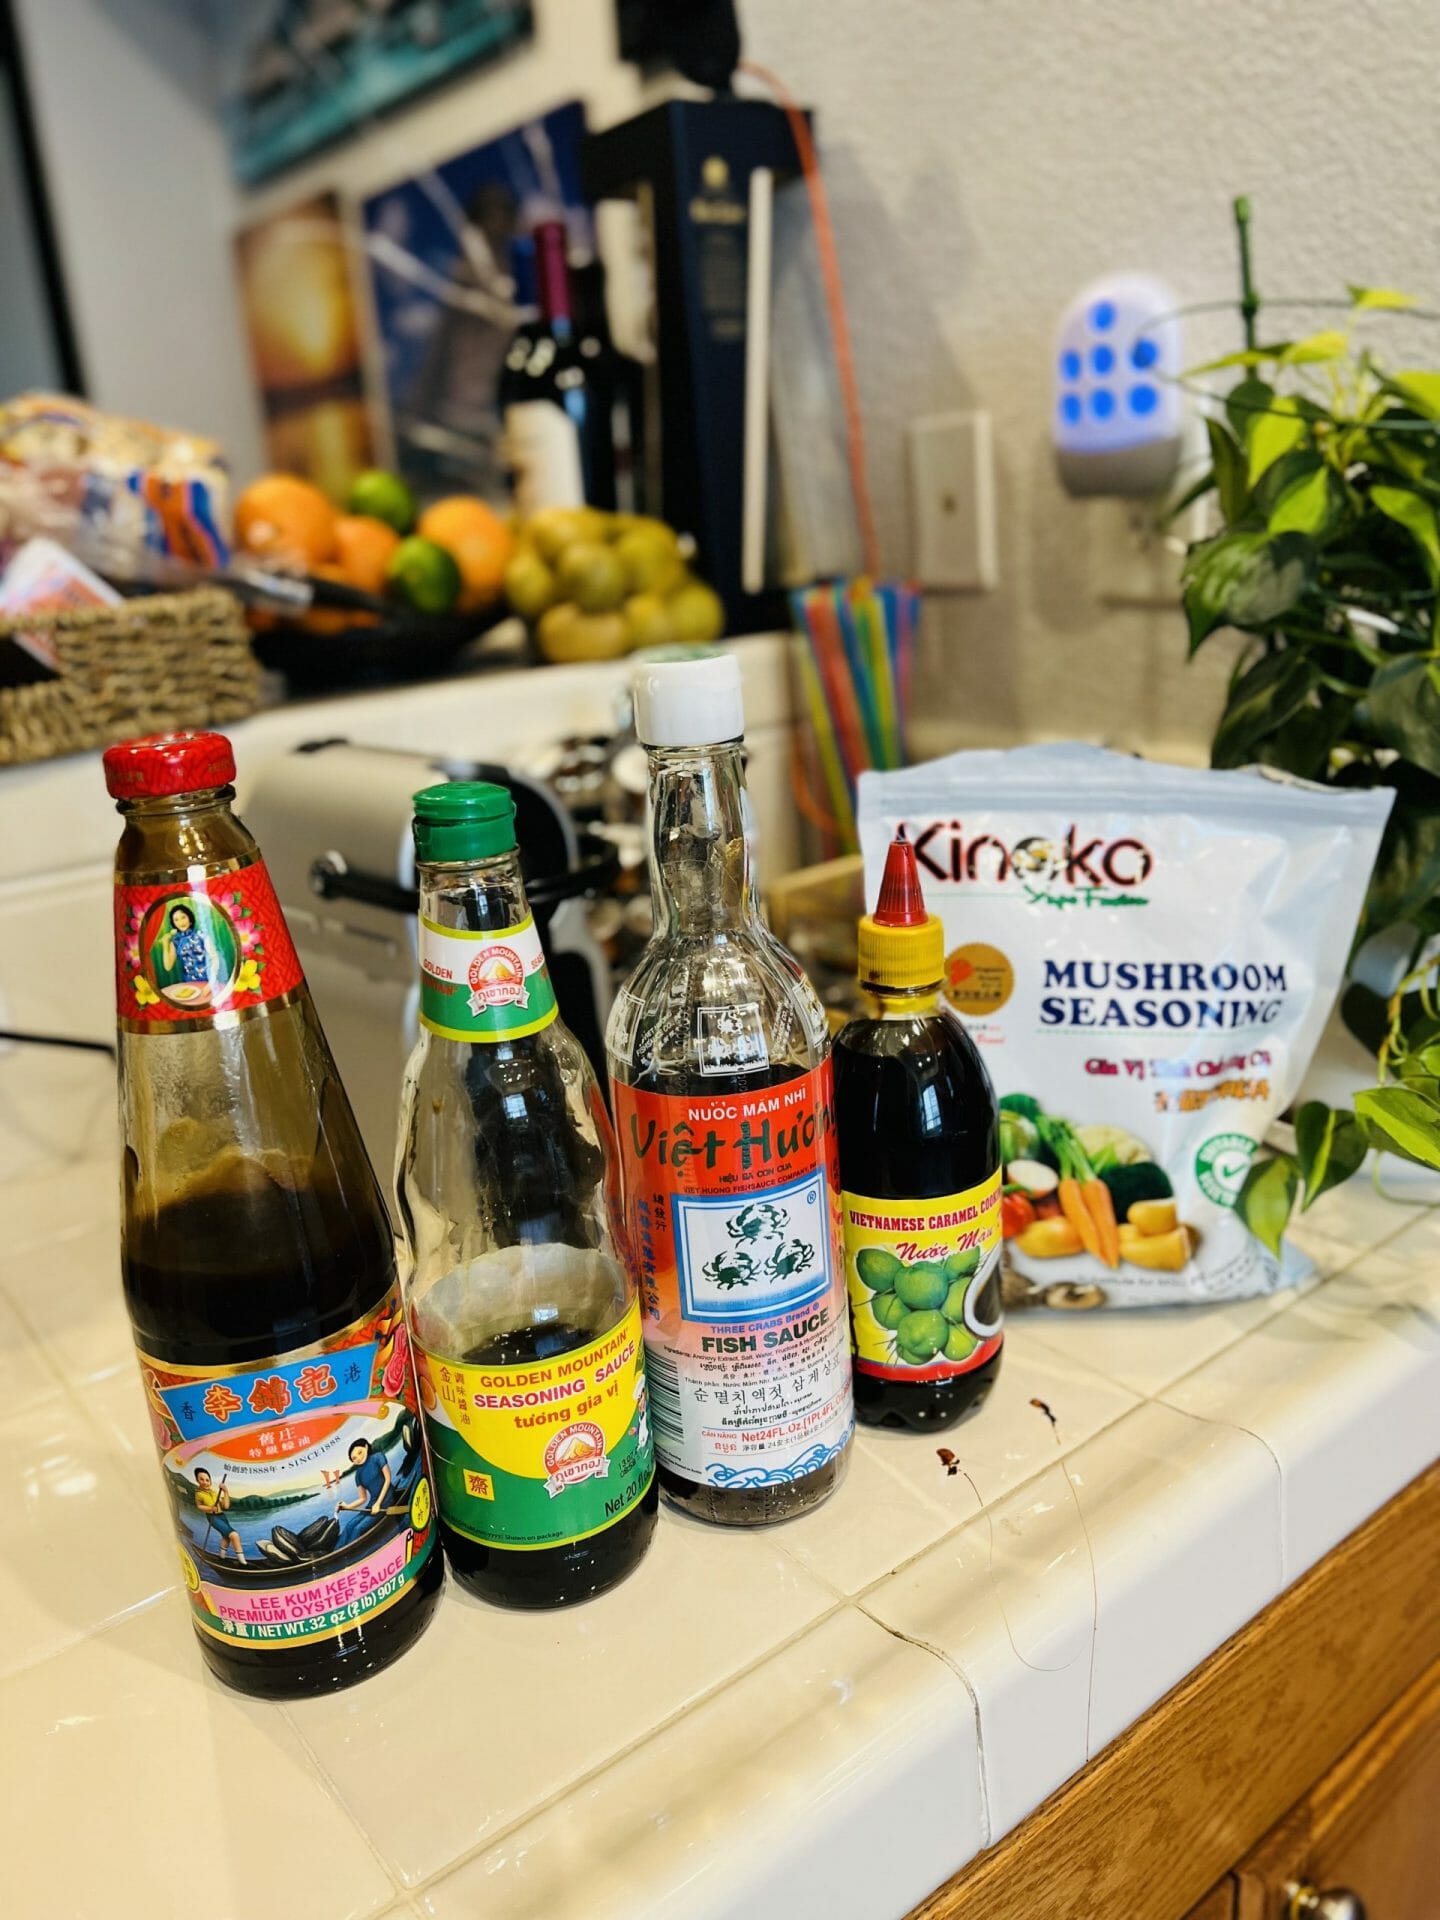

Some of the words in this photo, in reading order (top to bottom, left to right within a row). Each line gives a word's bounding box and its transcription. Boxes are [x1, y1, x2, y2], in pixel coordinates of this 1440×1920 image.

[423, 958, 453, 980] GOLDEN
[470, 950, 490, 984] GOLDEN
[491, 947, 523, 979] MOUNTAIN
[1044, 960, 1287, 992] MUSHROOM
[1039, 997, 1283, 1028] SEASONING
[630, 1113, 725, 1178] Việt
[702, 1187, 731, 1195] HUONG
[849, 1209, 925, 1231] VIETNAMESE
[928, 1205, 978, 1230] CARAMEL
[895, 1241, 949, 1262] Nước
[701, 1335, 757, 1354] FISH
[763, 1306, 830, 1349] SAUCE
[711, 1325, 746, 1335] THREE
[748, 1319, 784, 1332] CRABS
[786, 1309, 811, 1324] Brand
[473, 1378, 586, 1409] SEASONING
[595, 1339, 636, 1384] SAUCE
[480, 1369, 552, 1388] GOLDEN
[558, 1331, 627, 1378] MOUNTAIN
[693, 1353, 716, 1362] Anchovy
[181, 1401, 197, 1422] 香
[203, 1363, 338, 1424] 李錦記
[344, 1361, 361, 1385] 港
[440, 1366, 456, 1404] 金山
[576, 1393, 602, 1417] gia
[606, 1379, 620, 1397] vị
[546, 1429, 569, 1467] GOLDEN
[569, 1424, 604, 1450] MOUNTAIN
[604, 1492, 625, 1518] Net
[626, 1481, 637, 1502] 20
[537, 1531, 563, 1541] package
[219, 1605, 290, 1623] PREMIUM
[291, 1588, 355, 1619] OYSTER
[359, 1555, 405, 1595] SAUCE
[250, 1596, 281, 1610] LEE
[285, 1588, 322, 1607] KUM
[326, 1566, 371, 1596] KEE'S
[258, 1623, 283, 1638] NET
[284, 1620, 310, 1635] WT.
[310, 1615, 327, 1631] 32
[330, 1607, 347, 1624] oz
[377, 1581, 398, 1601] 907
[398, 1573, 405, 1587] g
